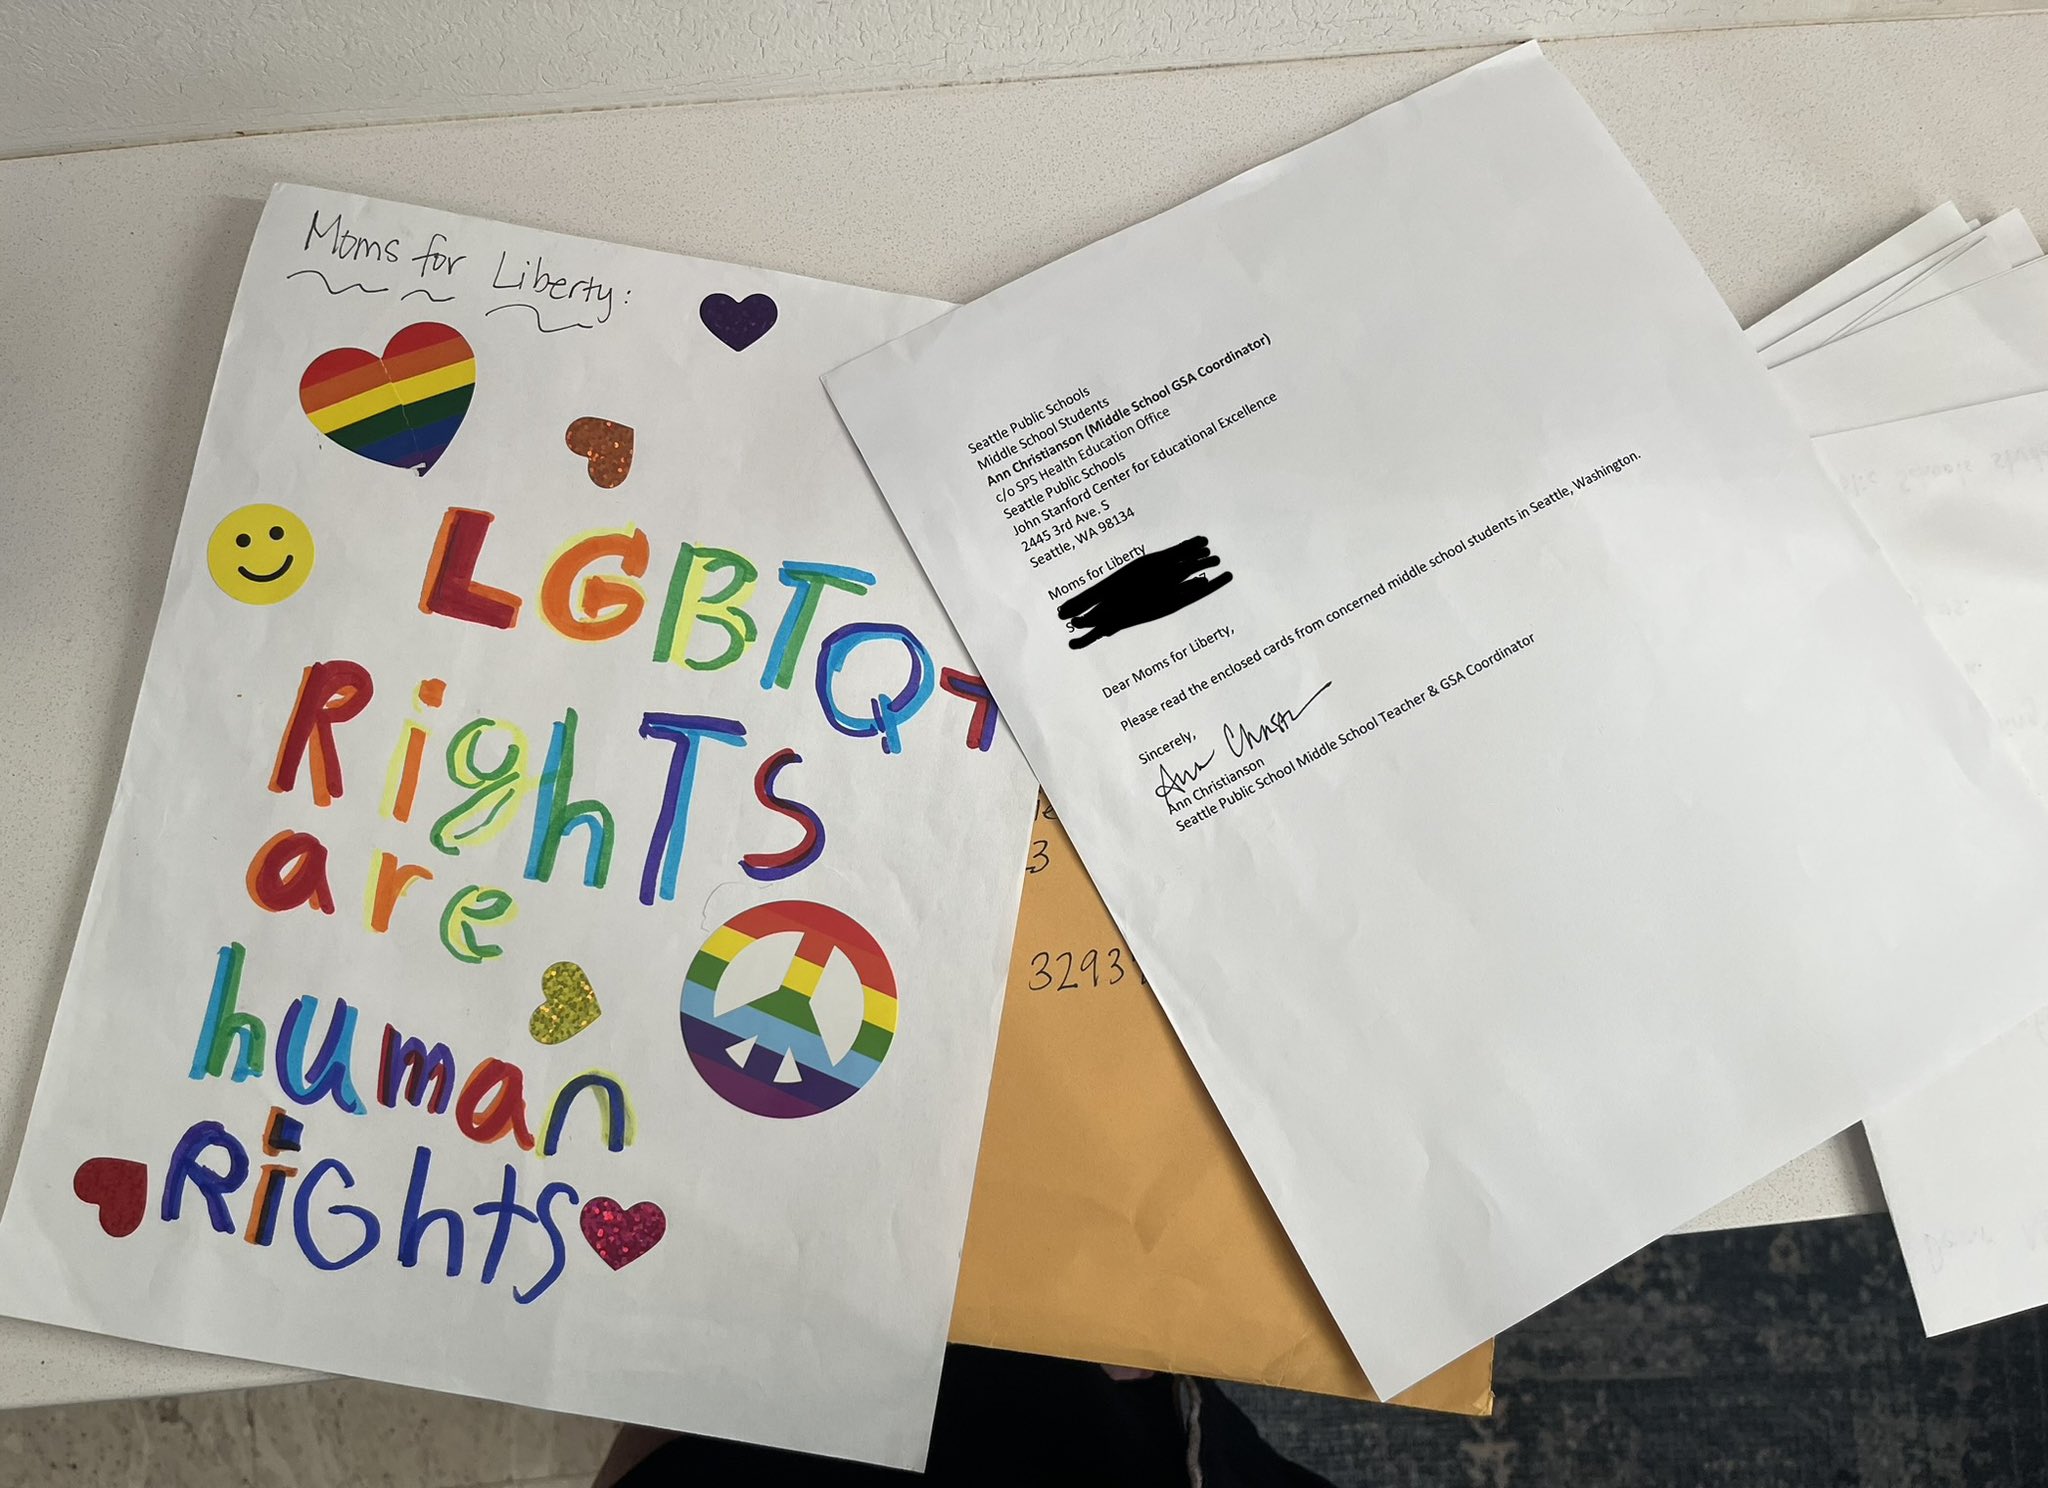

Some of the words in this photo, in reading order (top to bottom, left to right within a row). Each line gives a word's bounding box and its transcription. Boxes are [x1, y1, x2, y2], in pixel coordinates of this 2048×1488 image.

[304, 210, 400, 263] Moms
[411, 234, 467, 278] for
[492, 251, 632, 324] Liberty:
[968, 430, 1010, 454] Seattle
[1010, 411, 1046, 434] Public
[1046, 388, 1090, 415] Schools
[977, 446, 1019, 470] Middle
[1019, 422, 1058, 450] School
[1058, 398, 1110, 430] Students
[988, 470, 1012, 487] Ann
[1012, 433, 1085, 473] Christianson
[1085, 408, 1131, 438] (Middle
[1131, 385, 1171, 412] School
[1172, 373, 1198, 391] GSA
[1197, 333, 1271, 377] Coordinator)
[996, 488, 1015, 503] c/o
[1016, 474, 1038, 492] SPS
[1038, 456, 1078, 481] Health
[1078, 427, 1136, 461] Education
[1136, 409, 1171, 430] Office
[1004, 494, 1045, 520] Seattle
[1045, 475, 1082, 498] Public
[1081, 452, 1126, 480] Schools
[1013, 517, 1041, 536] John
[1041, 488, 1092, 521] Stanford
[1093, 469, 1131, 494] Center
[1132, 459, 1150, 474] for
[1151, 422, 1218, 464] Educational
[1218, 394, 1278, 429] Excellence
[1021, 530, 1051, 552] 2445
[1052, 518, 1074, 536] 3rd
[1076, 509, 1101, 526] Ave.
[1101, 500, 1110, 511] S
[1030, 543, 1075, 568] Seattle,
[1074, 528, 1099, 544] WA
[1098, 507, 1135, 533] 98134
[1048, 576, 1086, 601] Moms
[1086, 566, 1104, 581] for
[1105, 544, 1146, 571] Liberty
[1120, 707, 1159, 732] Please
[1160, 689, 1188, 711] read
[1188, 681, 1209, 696] the
[1211, 650, 1262, 685] enclosed
[1263, 635, 1295, 656] cards
[1295, 619, 1325, 639] from
[1326, 583, 1387, 623] concerned
[1387, 564, 1428, 590] middle
[1429, 540, 1467, 568] school
[1468, 516, 1518, 547] students
[1516, 509, 1531, 520] in
[1529, 488, 1574, 513] Seattle,
[1572, 453, 1641, 489] Washington.
[1102, 678, 1130, 699] Dear
[1132, 659, 1170, 683] Moms
[1170, 648, 1188, 663] for
[1189, 626, 1234, 653] Liberty,
[1139, 732, 1196, 765] Sincerely,
[1176, 806, 1219, 832] Seattle
[1218, 785, 1256, 809] Public
[1255, 761, 1296, 790] School
[1296, 741, 1338, 768] Middle
[1338, 716, 1379, 745] School
[1378, 693, 1426, 723] Teacher
[1427, 685, 1440, 697] &
[1440, 672, 1467, 690] GSA
[1466, 634, 1535, 676] Coordinator
[1169, 798, 1193, 815] Ann
[1193, 759, 1265, 801] Christianson
[246, 829, 519, 964] are
[1028, 948, 1149, 991] 3293
[188, 941, 637, 1159] human
